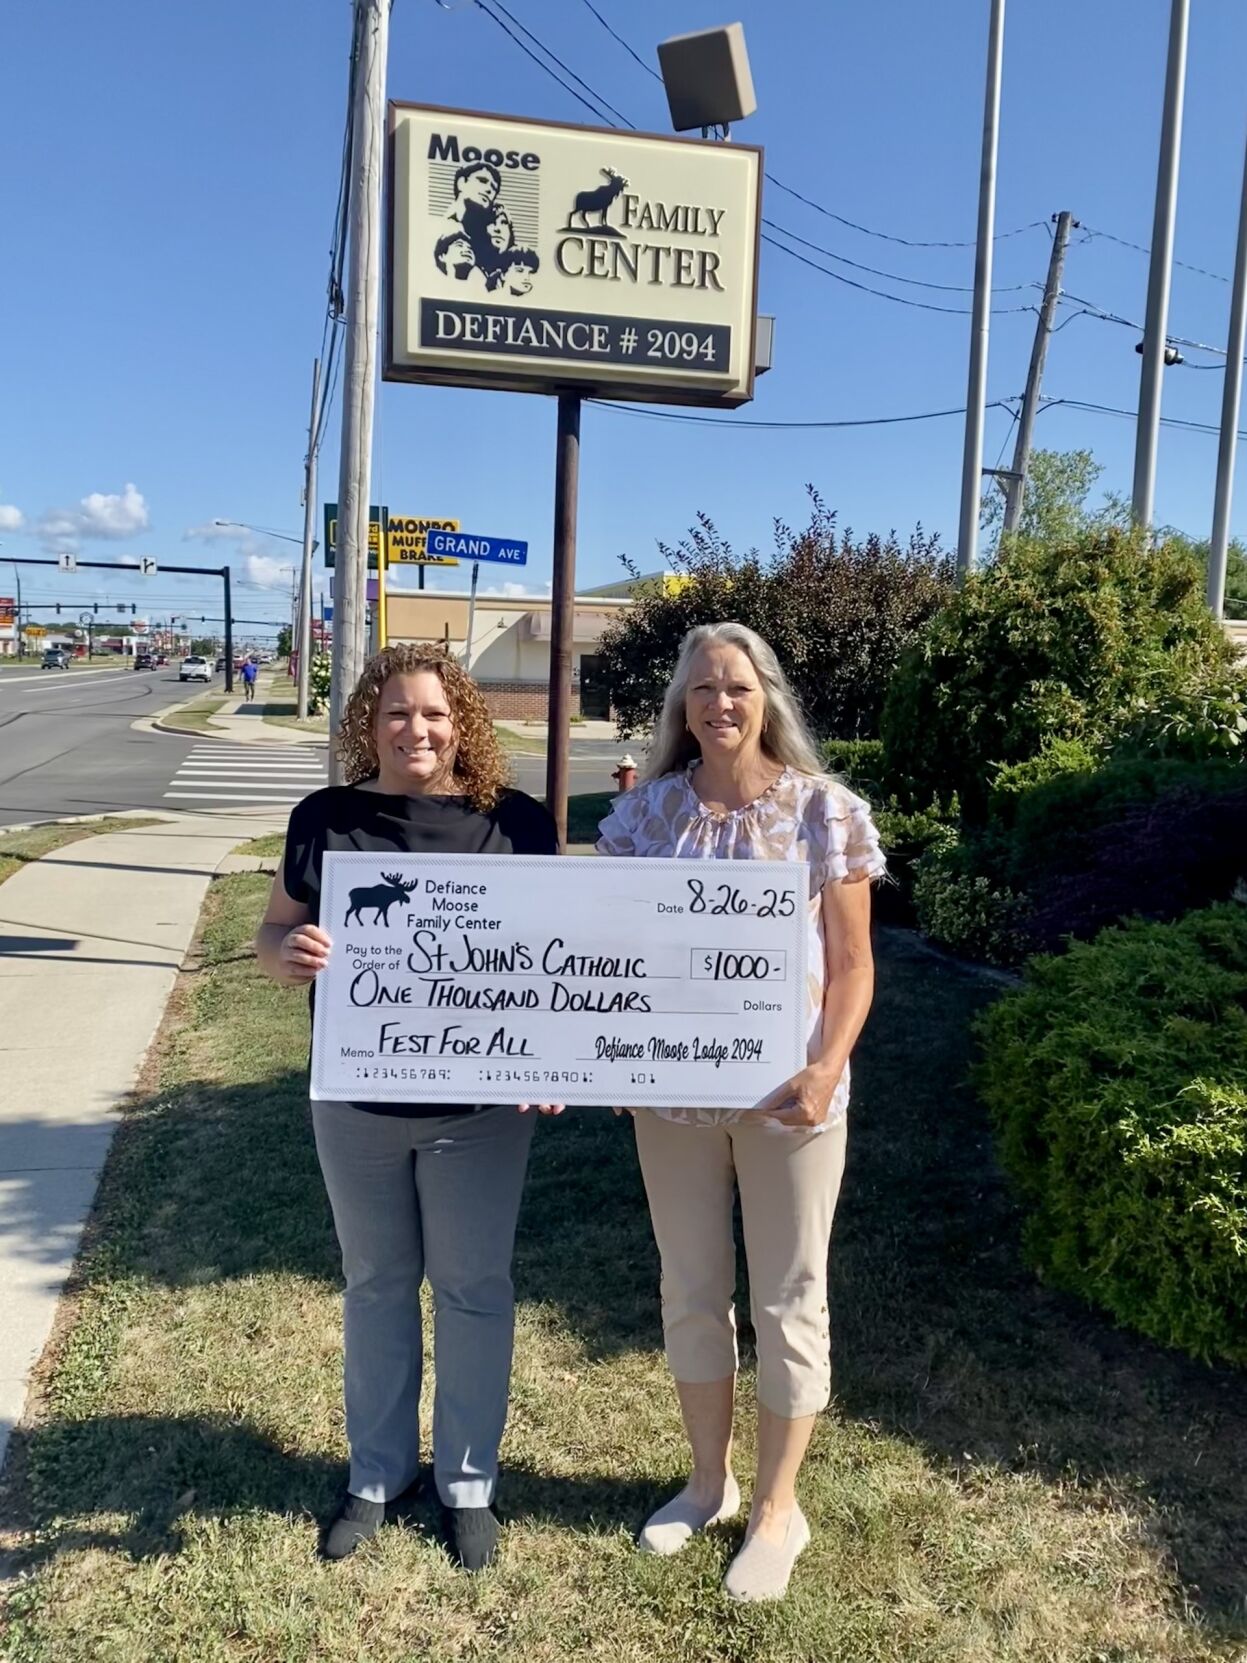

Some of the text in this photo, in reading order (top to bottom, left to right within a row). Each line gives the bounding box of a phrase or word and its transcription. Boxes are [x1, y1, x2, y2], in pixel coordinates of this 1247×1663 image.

[428, 133, 541, 171] Moose
[620, 192, 726, 236] FAMILY
[555, 237, 726, 292] CENTER
[435, 310, 716, 361] DEFIANCE # 2094
[392, 535, 427, 547] MUFF
[434, 536, 521, 560] GRAND AVE
[425, 880, 487, 894] Defiance
[687, 879, 795, 918] 8-26-25
[432, 897, 479, 912] Moose
[657, 903, 684, 913] Date
[407, 914, 502, 932] Family Center
[345, 944, 402, 957] Pay to the
[542, 938, 647, 978] CATHOLIC
[352, 959, 401, 970] Order of
[418, 977, 539, 1011] THOUSAND
[550, 982, 652, 1013] DOLLARS
[743, 1000, 782, 1011] Dollars
[379, 1021, 435, 1054] FEST
[340, 1047, 374, 1058] Memo
[595, 1035, 763, 1068] Defiance Moose Lodge 2094
